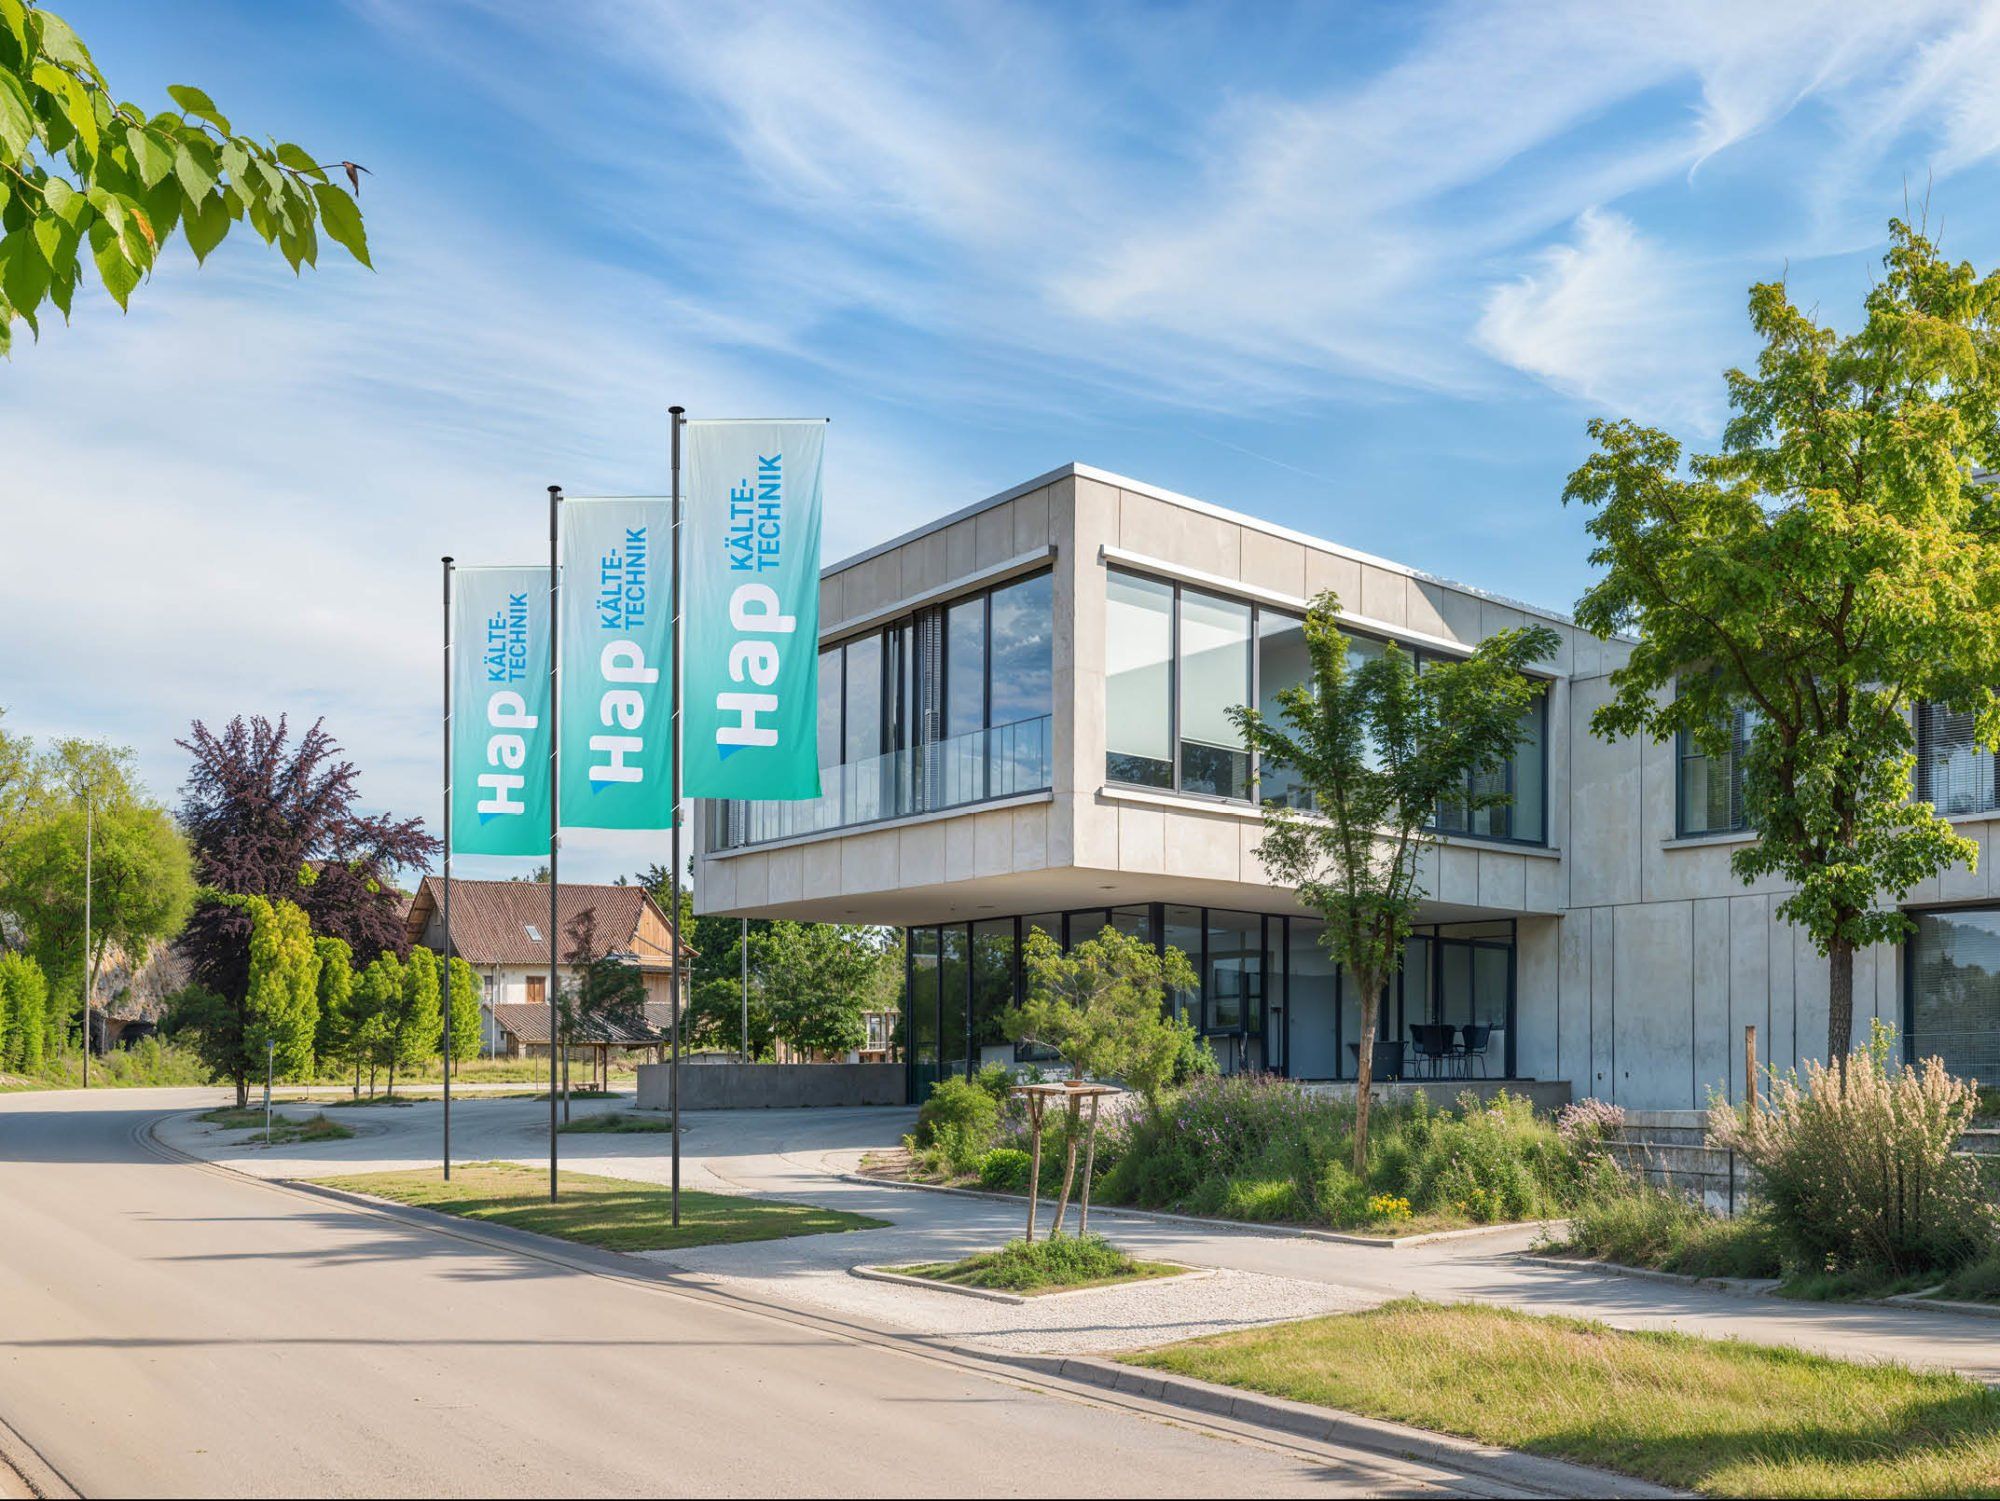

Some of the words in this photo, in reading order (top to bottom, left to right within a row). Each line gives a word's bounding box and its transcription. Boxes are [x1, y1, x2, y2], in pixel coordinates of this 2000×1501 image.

[724, 478, 755, 571] KÄLTE-
[757, 454, 782, 573] TECHNIK
[597, 548, 622, 630] KÄLTE-
[625, 527, 647, 631] TECHNIK
[484, 611, 507, 682] KÄLTE-
[509, 592, 528, 683] TECHNIK
[716, 583, 796, 746] Hap
[477, 690, 539, 814] Hap
[589, 639, 659, 783] Hap
